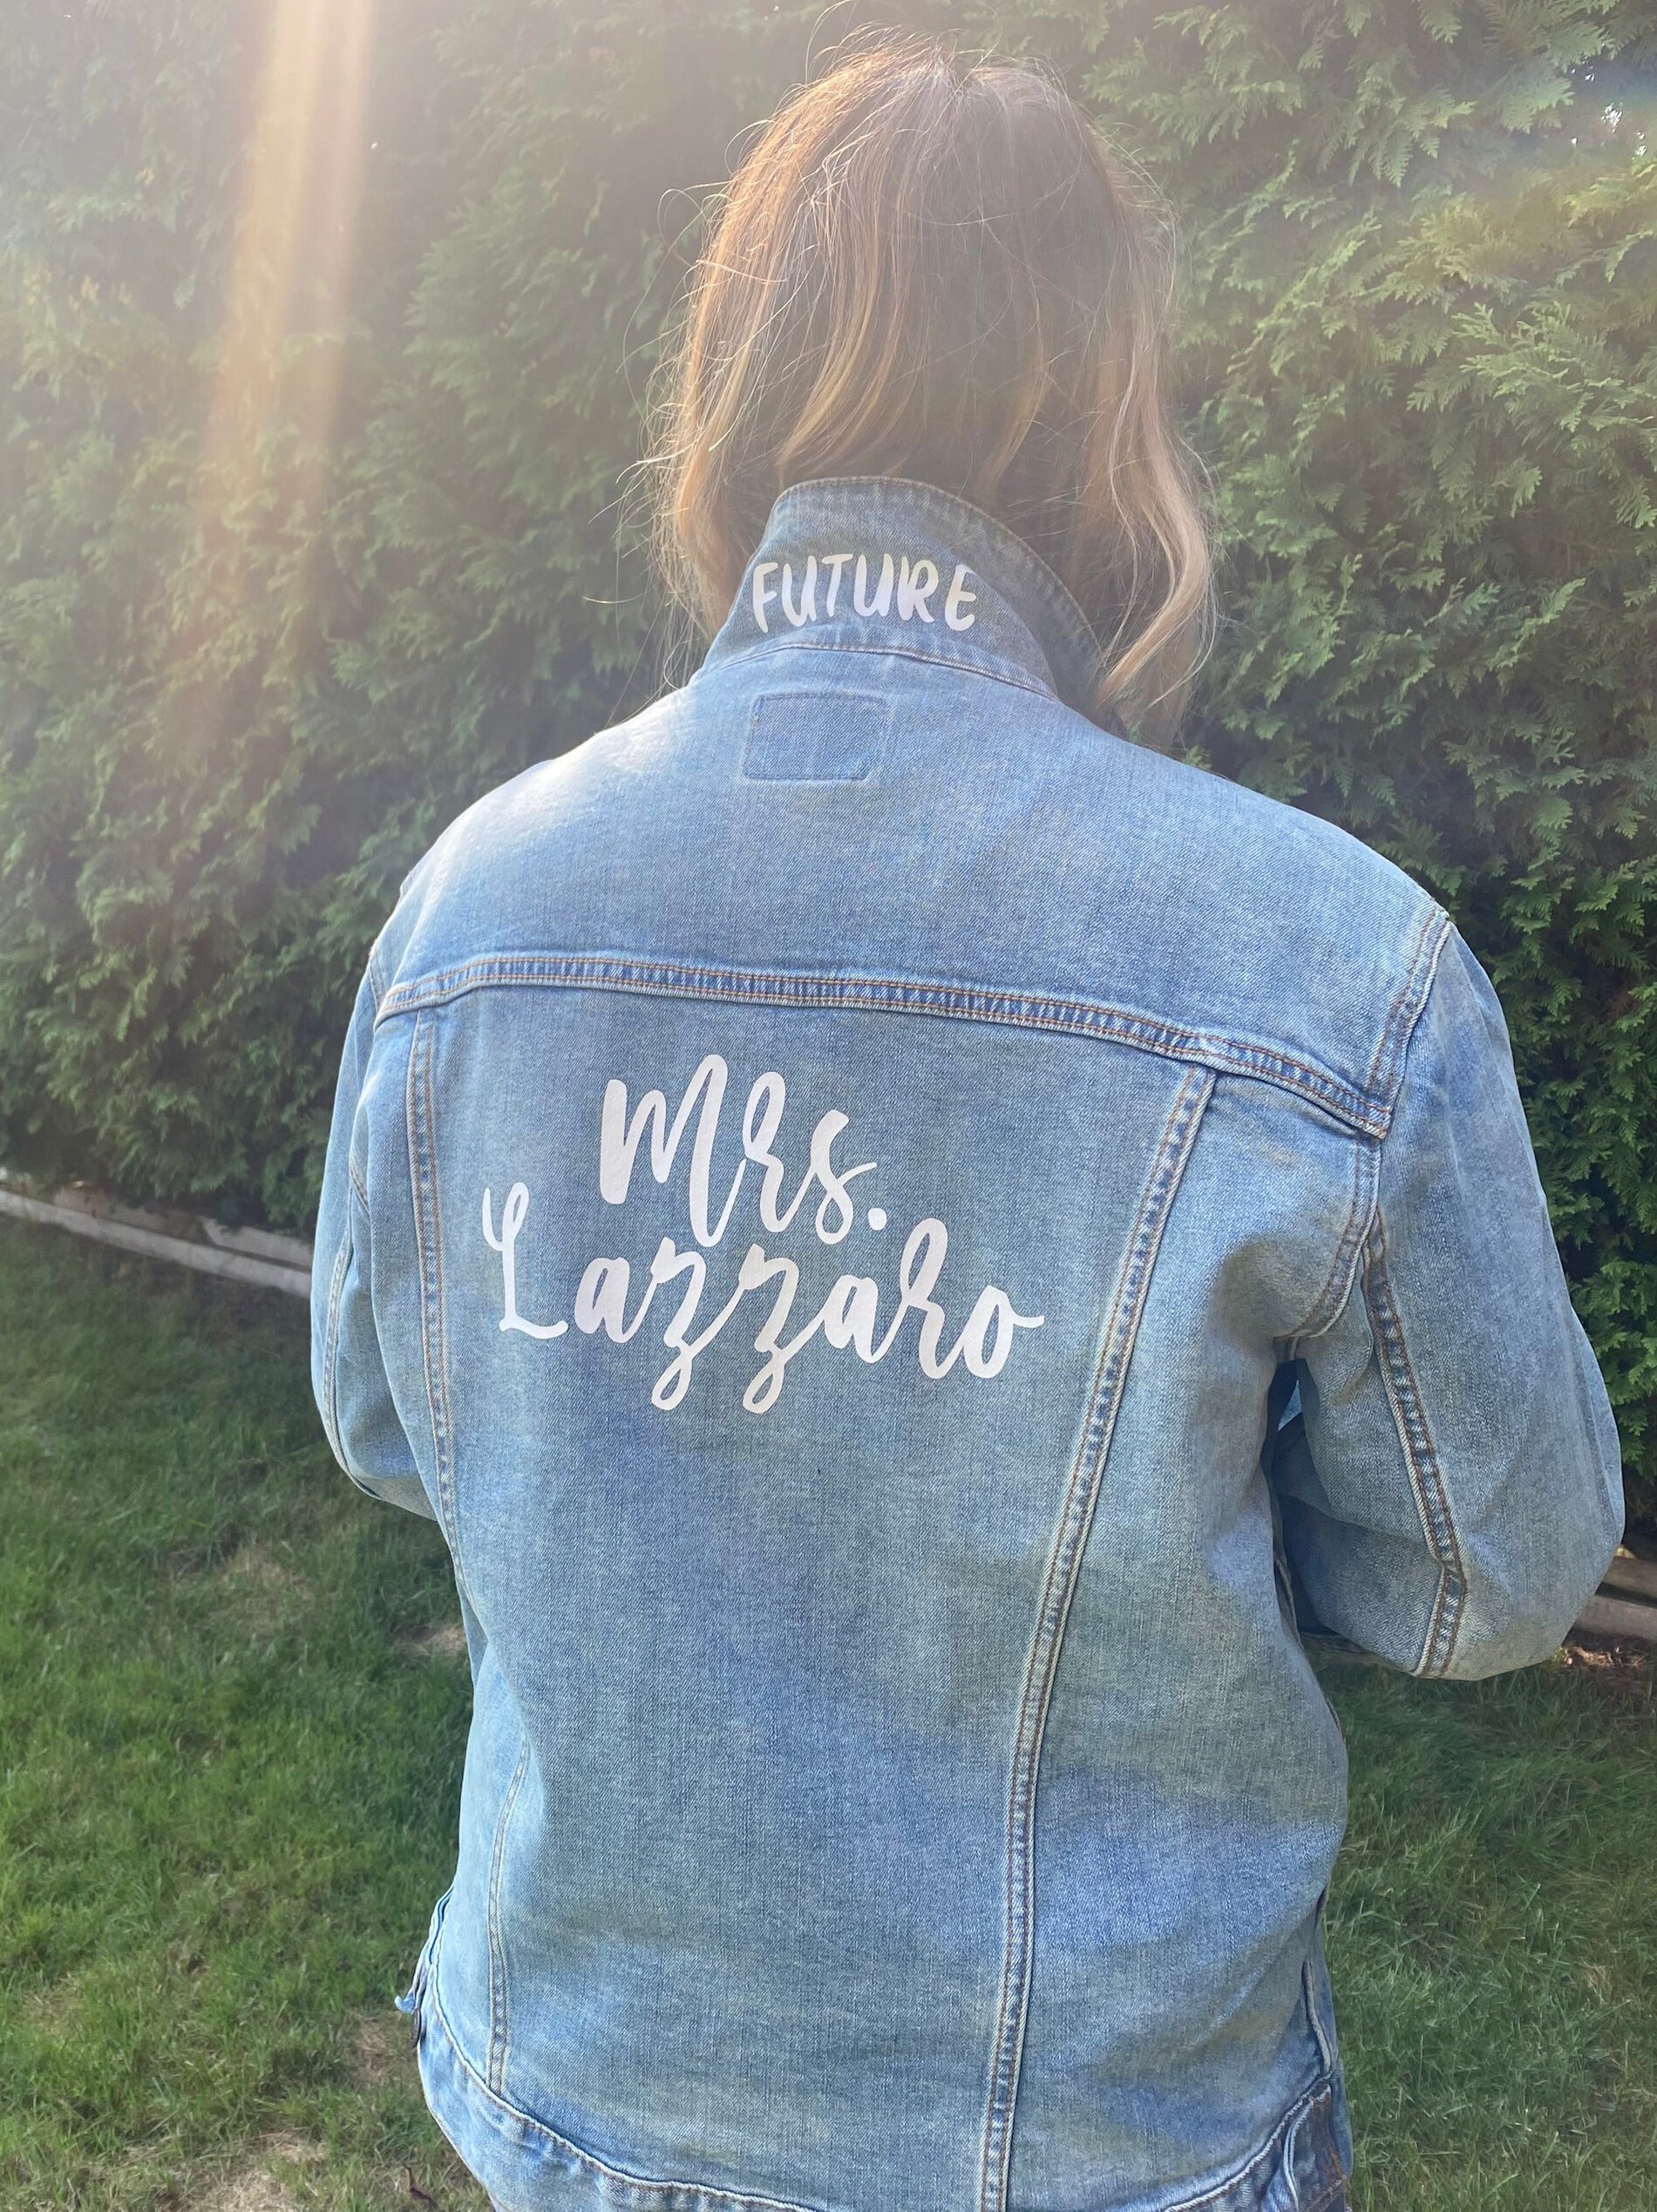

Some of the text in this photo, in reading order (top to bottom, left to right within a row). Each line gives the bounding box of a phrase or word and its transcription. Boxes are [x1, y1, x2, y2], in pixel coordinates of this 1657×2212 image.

[752, 553, 977, 633] FUTURE
[600, 1054, 887, 1247] Mrs.
[482, 1182, 1044, 1414] Lazzaro
